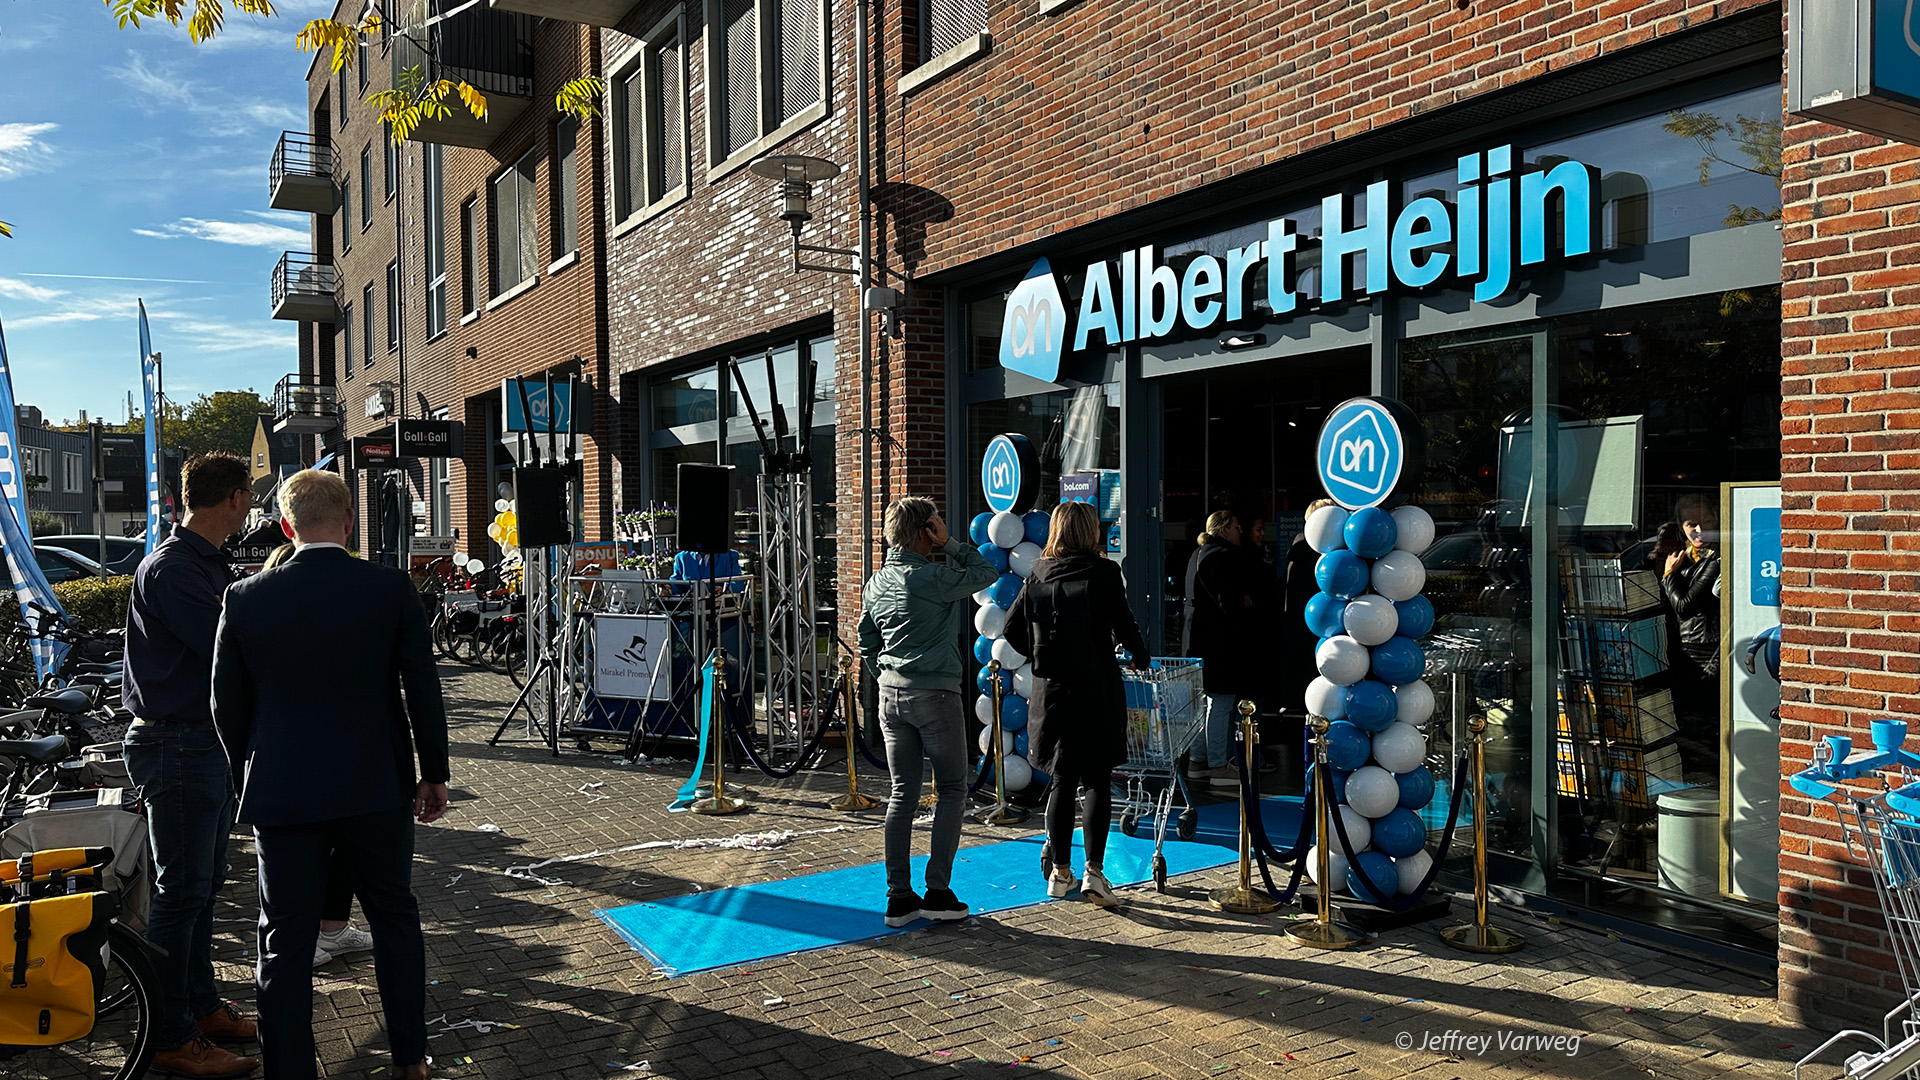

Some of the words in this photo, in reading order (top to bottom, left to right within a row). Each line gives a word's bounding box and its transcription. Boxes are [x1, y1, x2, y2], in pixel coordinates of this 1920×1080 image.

[1073, 218, 1296, 352] Albert
[1322, 144, 1590, 303] Heijn
[1063, 482, 1089, 491] bol.com
[575, 547, 625, 560] BONUS
[600, 668, 625, 677] Mirakel
